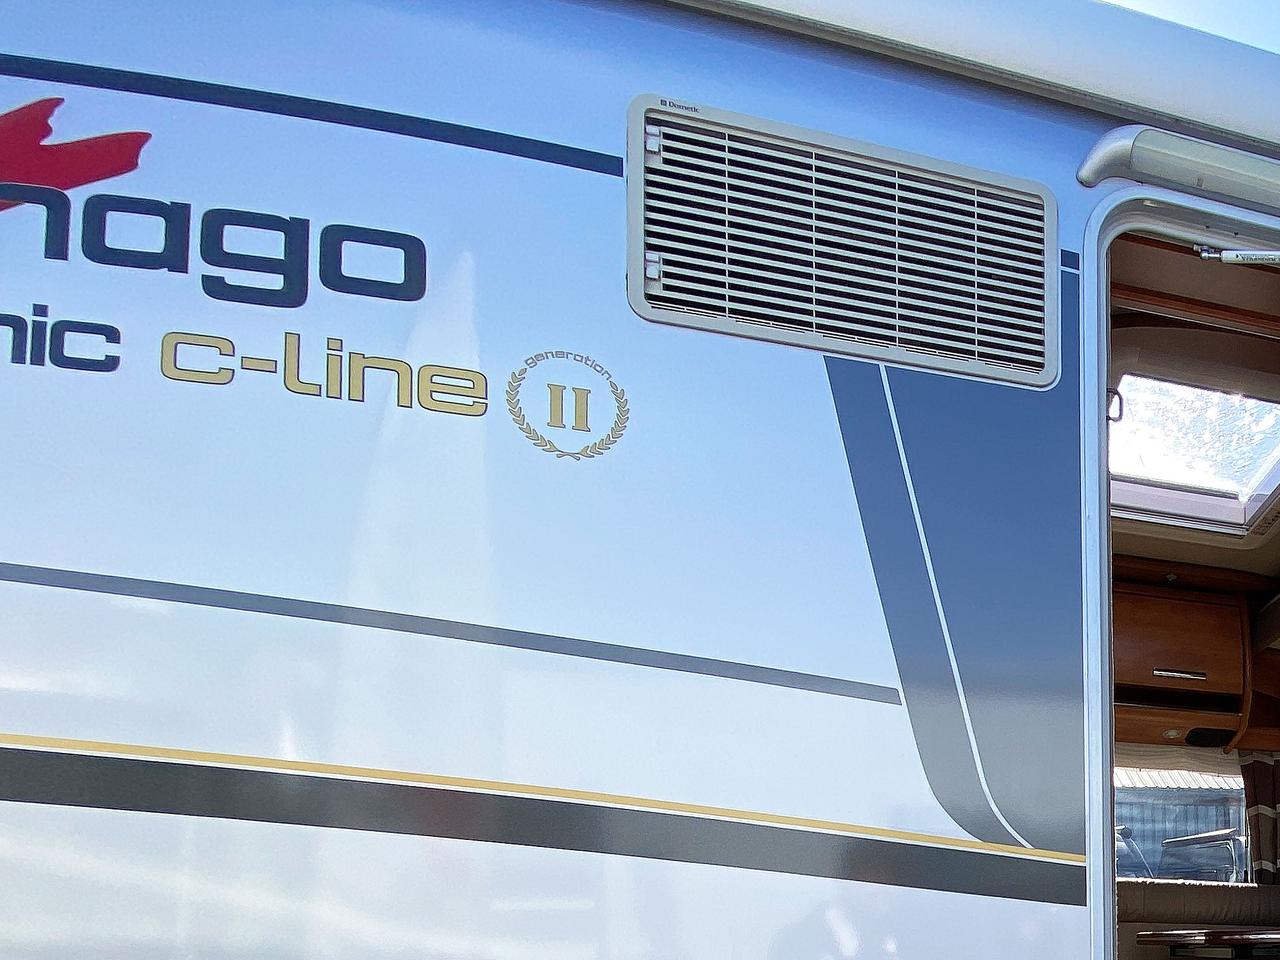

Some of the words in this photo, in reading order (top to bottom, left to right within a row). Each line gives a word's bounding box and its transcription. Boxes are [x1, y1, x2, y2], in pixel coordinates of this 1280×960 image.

[668, 99, 701, 114] Dometic
[161, 331, 488, 417] c-line
[524, 350, 613, 381] generation
[546, 383, 591, 432] II
